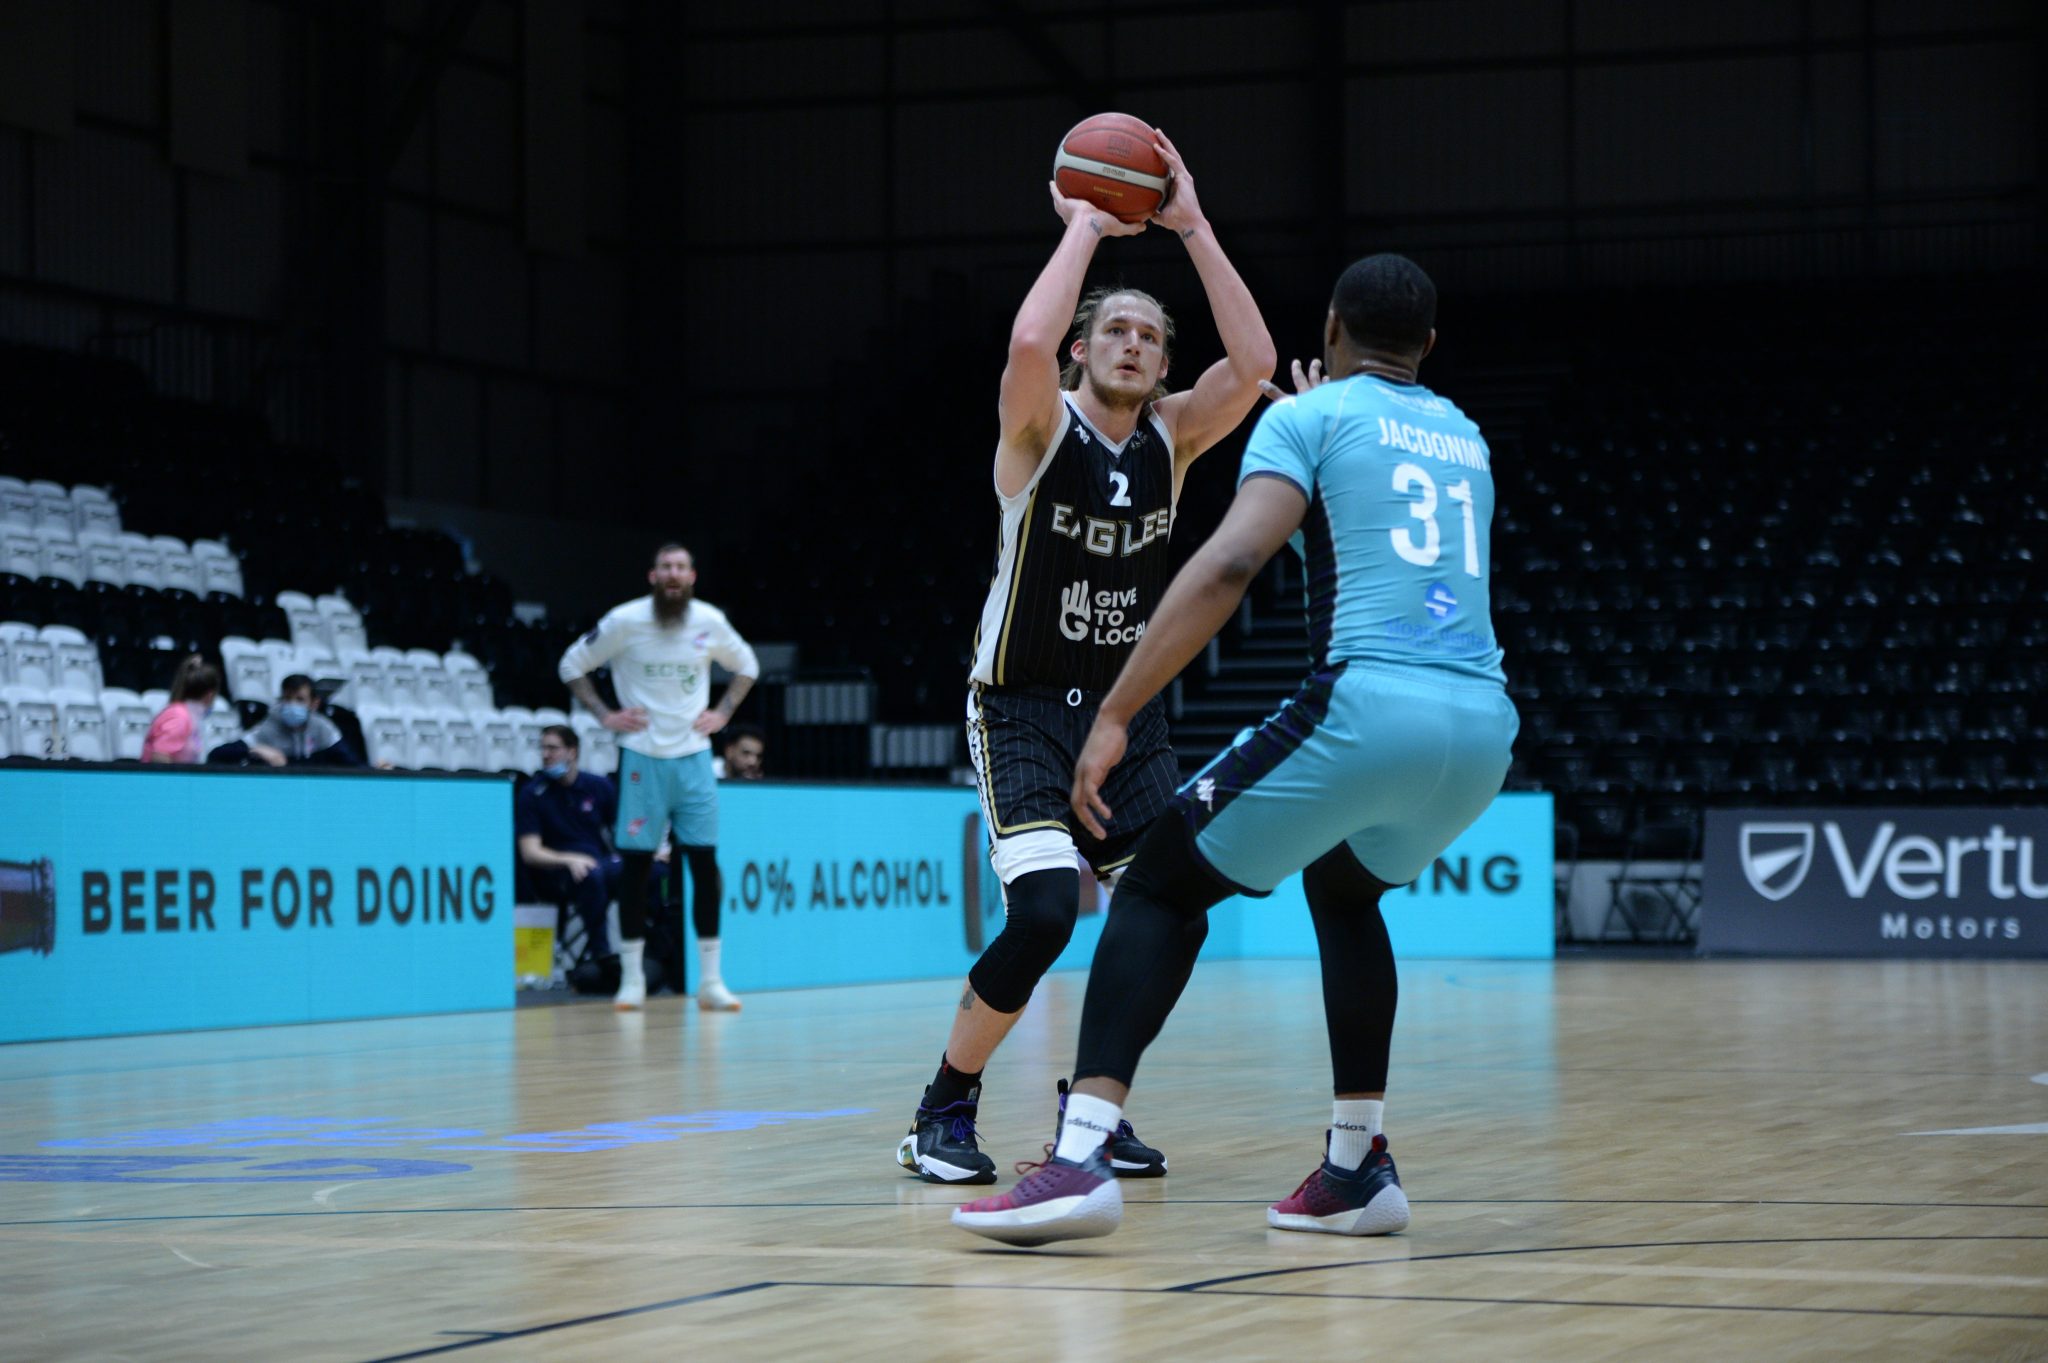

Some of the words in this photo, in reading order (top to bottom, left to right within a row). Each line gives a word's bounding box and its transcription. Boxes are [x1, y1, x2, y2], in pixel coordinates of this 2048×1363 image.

[1109, 471, 1132, 507] 2
[1390, 462, 1480, 578] 31
[1095, 587, 1137, 608] GIVE
[1094, 608, 1125, 627] TO
[1823, 821, 2048, 900] Vertu
[81, 868, 216, 935] BEER
[240, 866, 334, 930] FOR
[356, 864, 496, 927] DOING
[718, 857, 796, 916] .0%
[809, 858, 950, 911] ALCOHOL
[1881, 911, 2021, 940] Motors
[1333, 1120, 1367, 1132] didas
